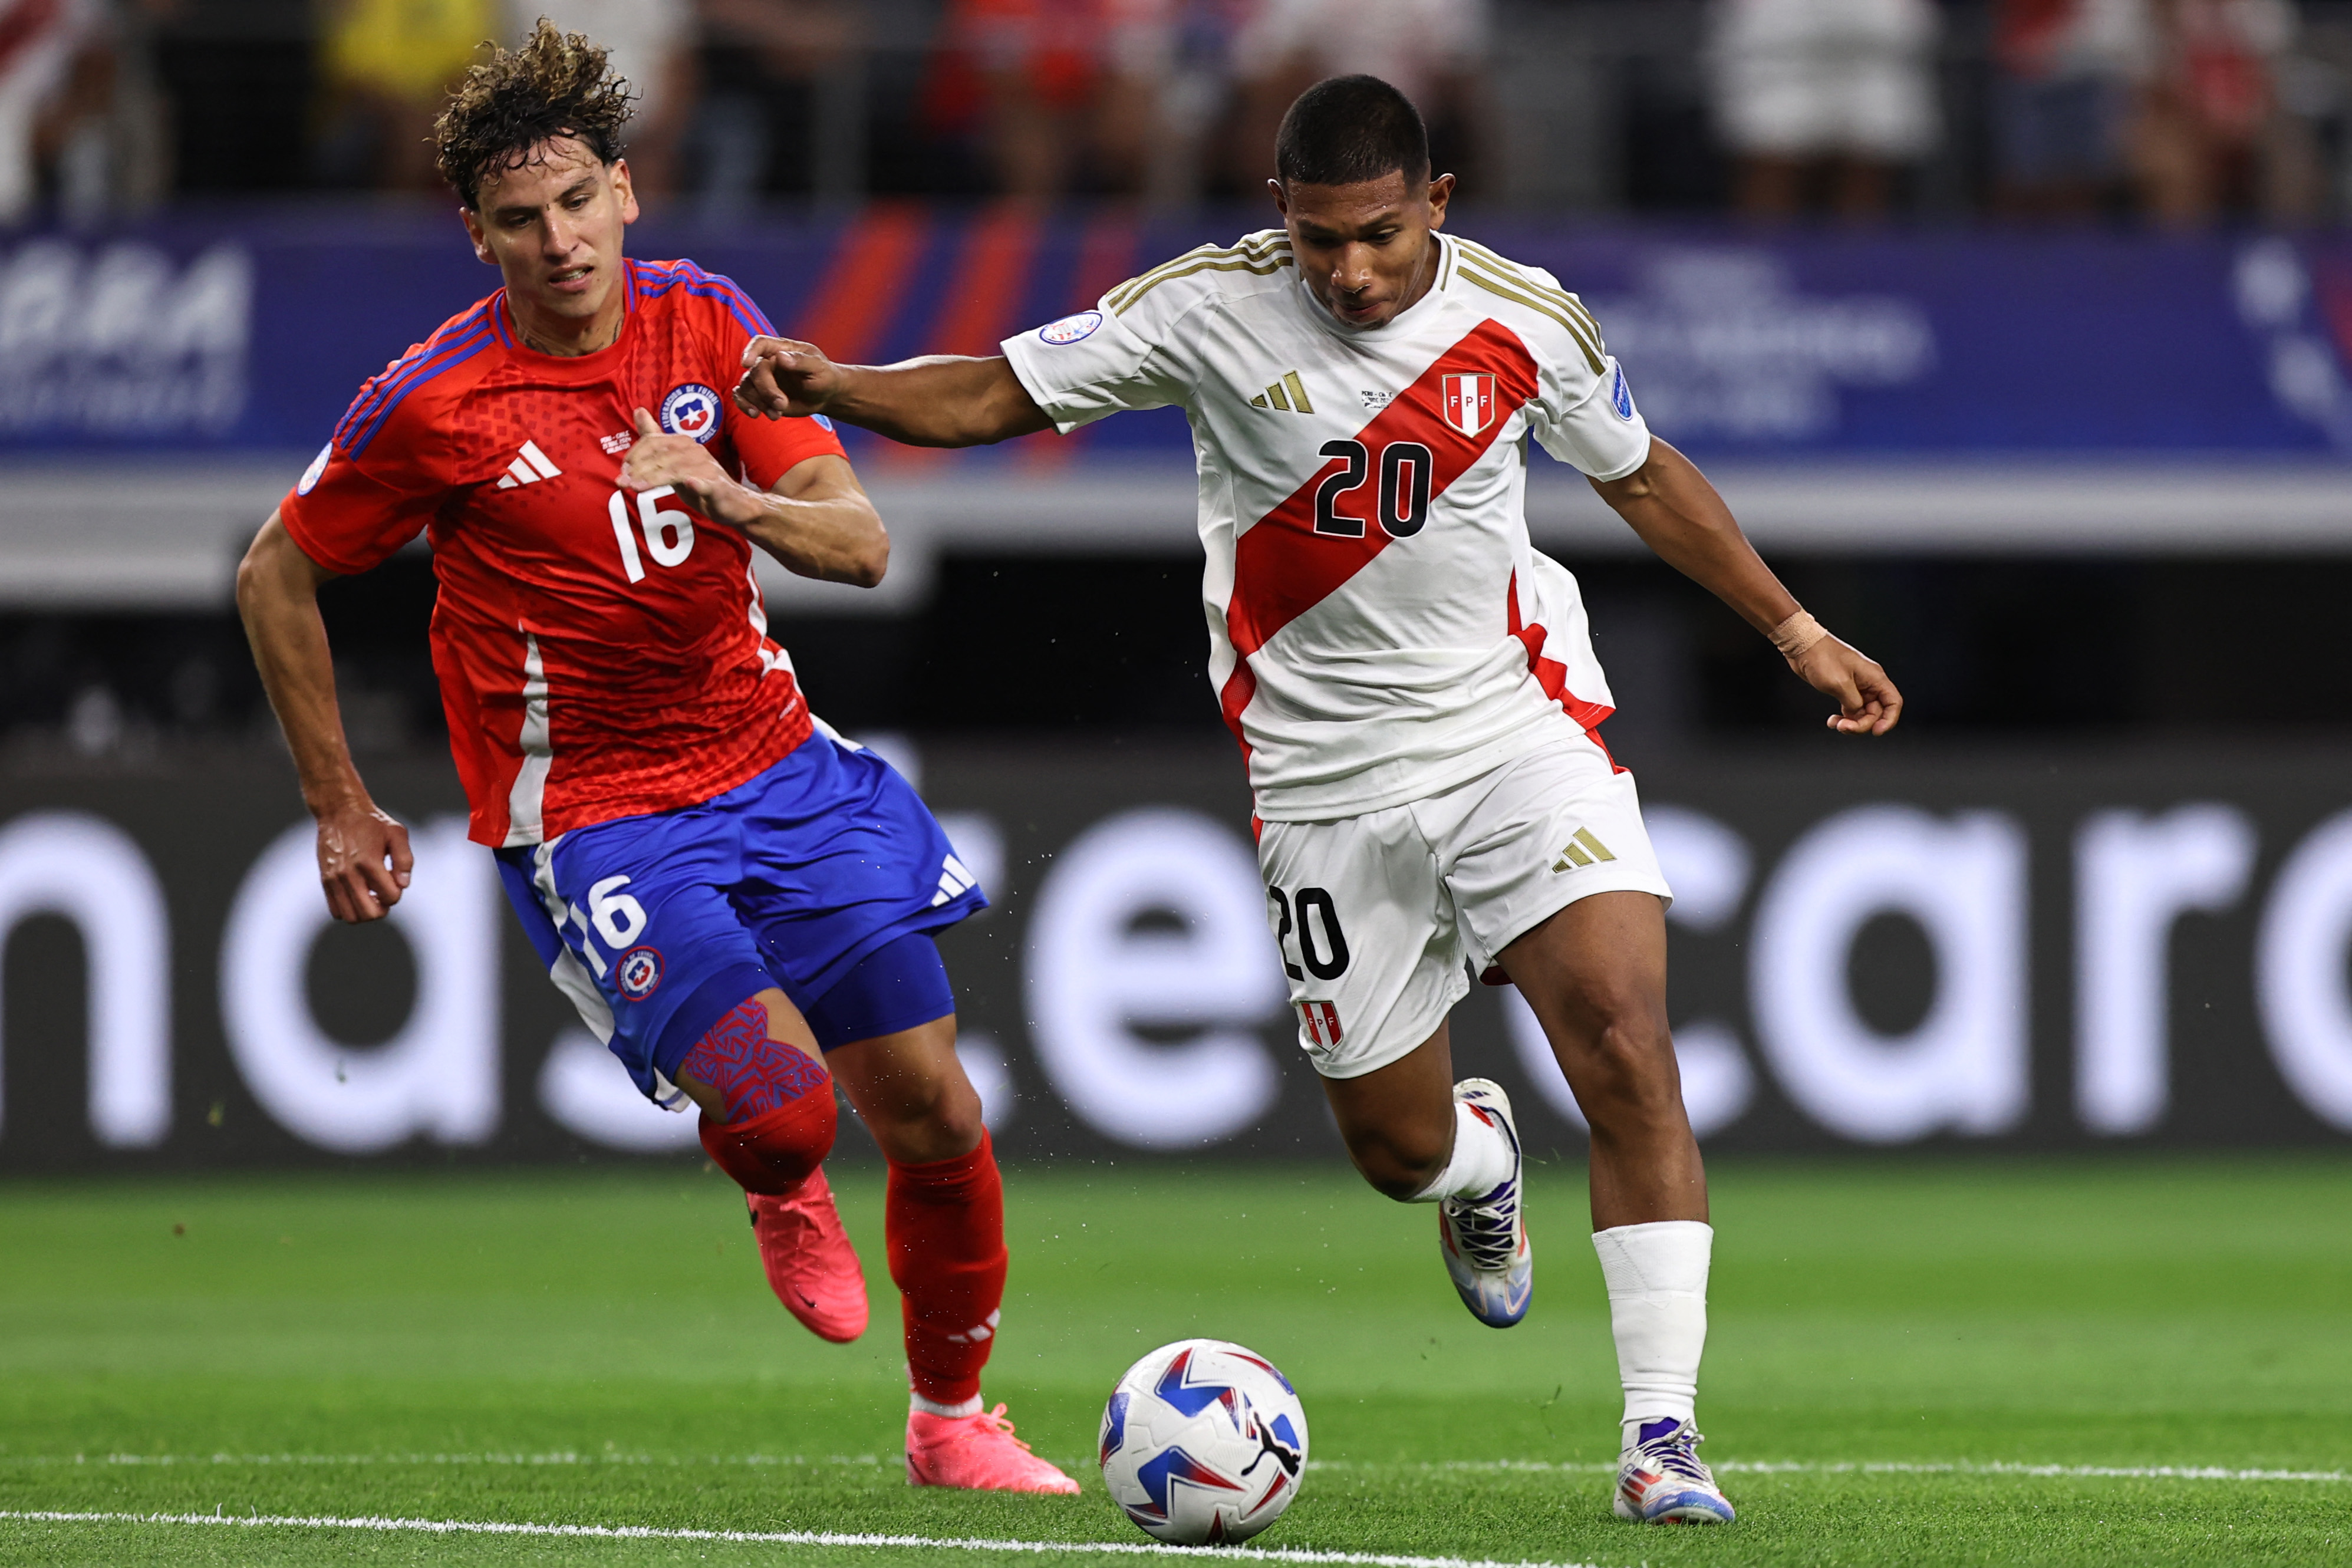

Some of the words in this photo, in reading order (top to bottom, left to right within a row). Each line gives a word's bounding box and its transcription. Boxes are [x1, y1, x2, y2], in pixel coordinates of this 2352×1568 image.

[1450, 396, 1488, 407] FPF
[608, 485, 694, 584] 16
[1313, 437, 1433, 539] 20
[569, 875, 647, 980] 16
[1269, 885, 1349, 981] 20
[1308, 1016, 1334, 1030] FPF
